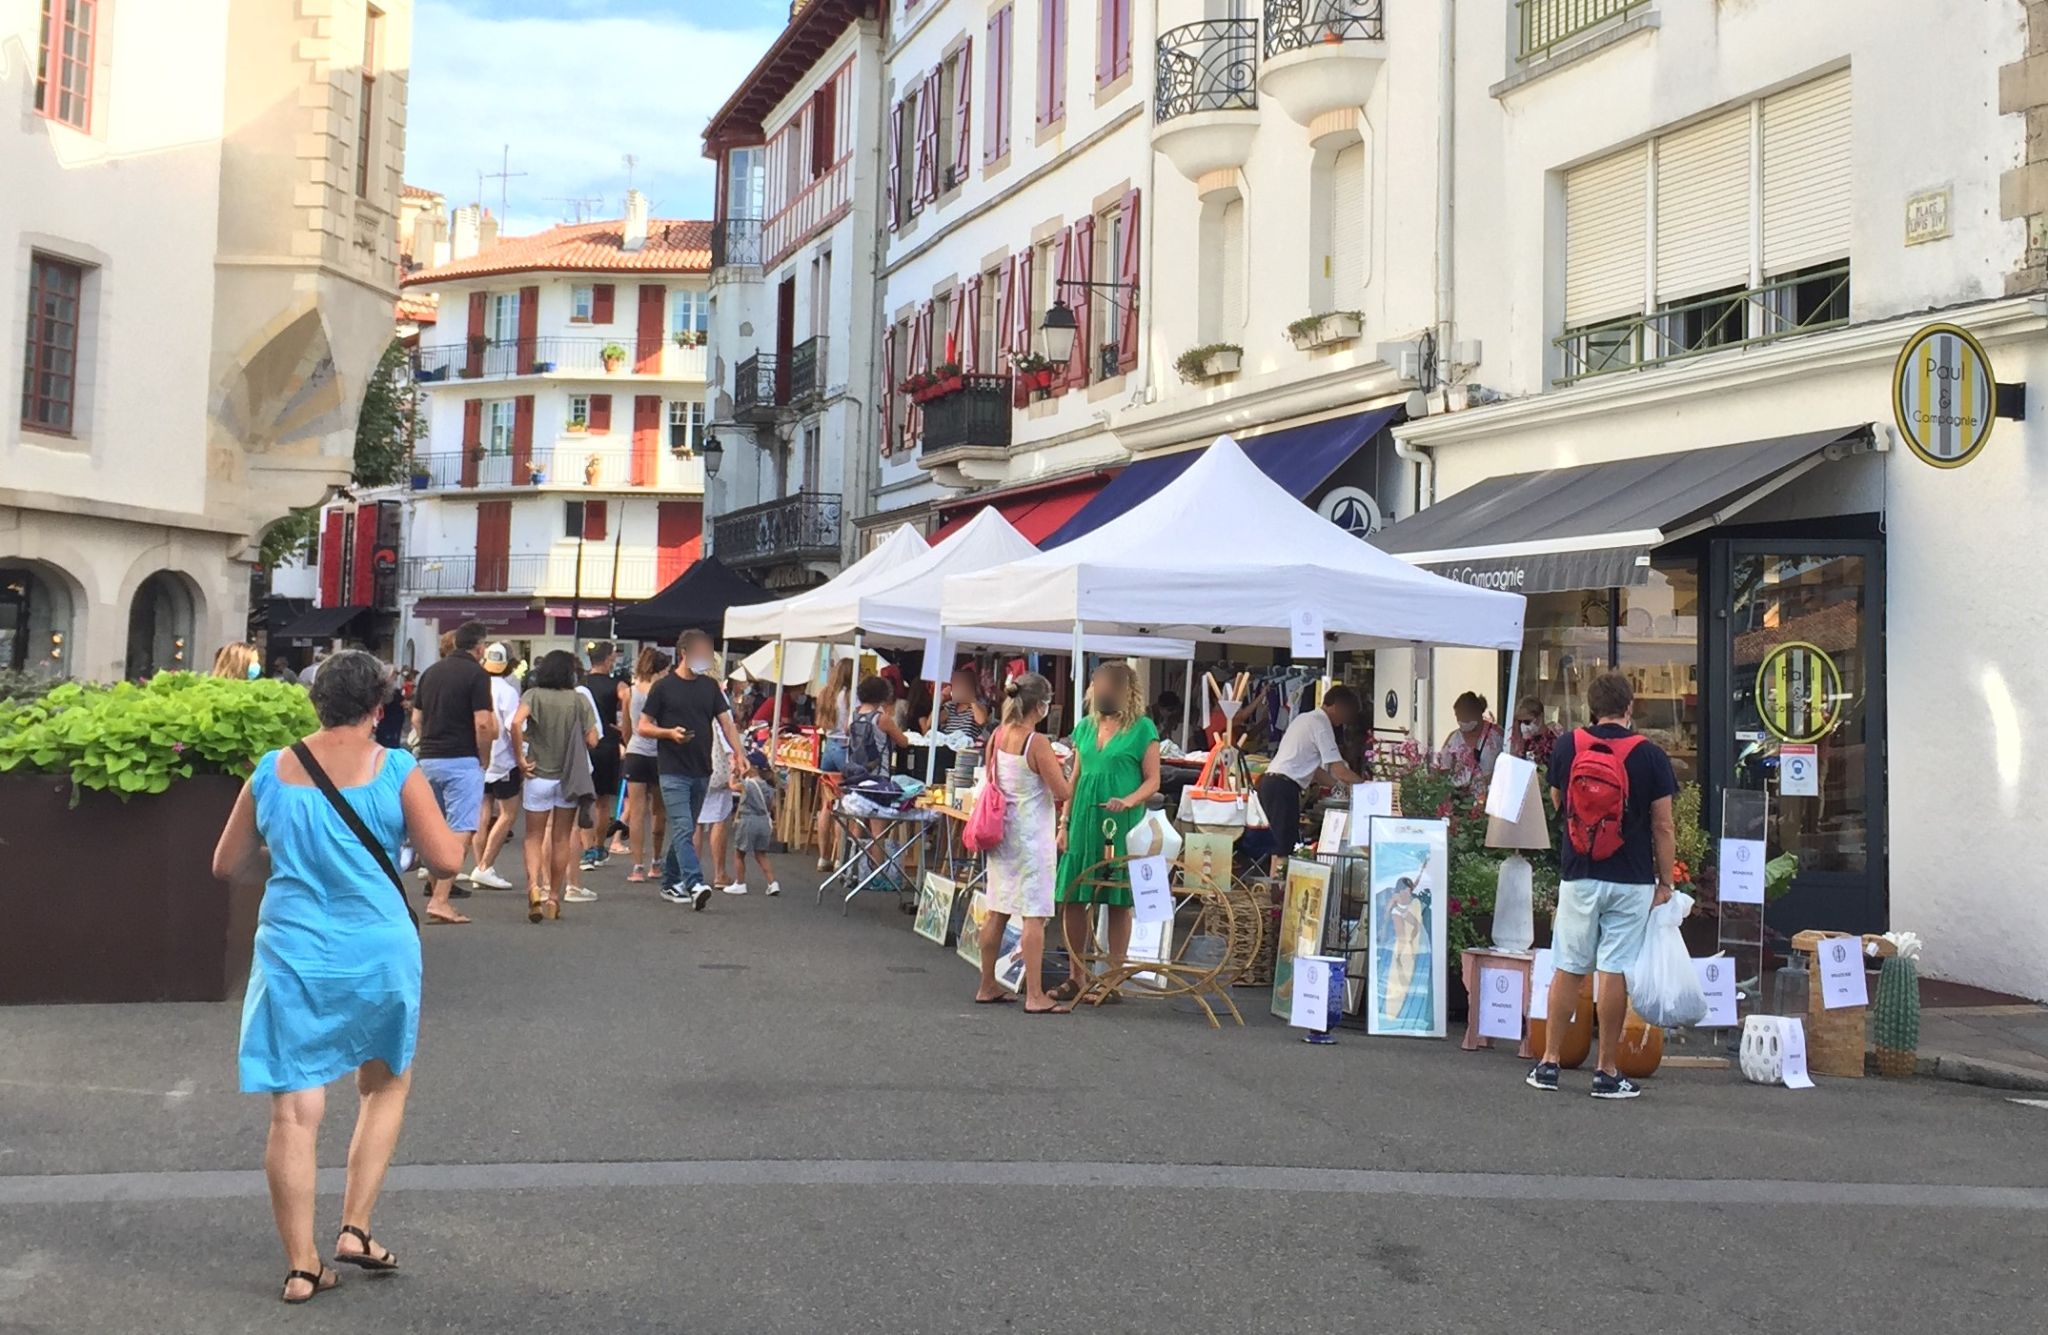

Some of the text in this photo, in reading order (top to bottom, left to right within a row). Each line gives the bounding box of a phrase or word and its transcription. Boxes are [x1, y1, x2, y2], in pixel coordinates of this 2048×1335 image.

[1926, 358, 1965, 381] Paul
[1939, 389, 1951, 409] &
[1912, 410, 1978, 427] Compagnie
[1461, 567, 1525, 590] Compagnie
